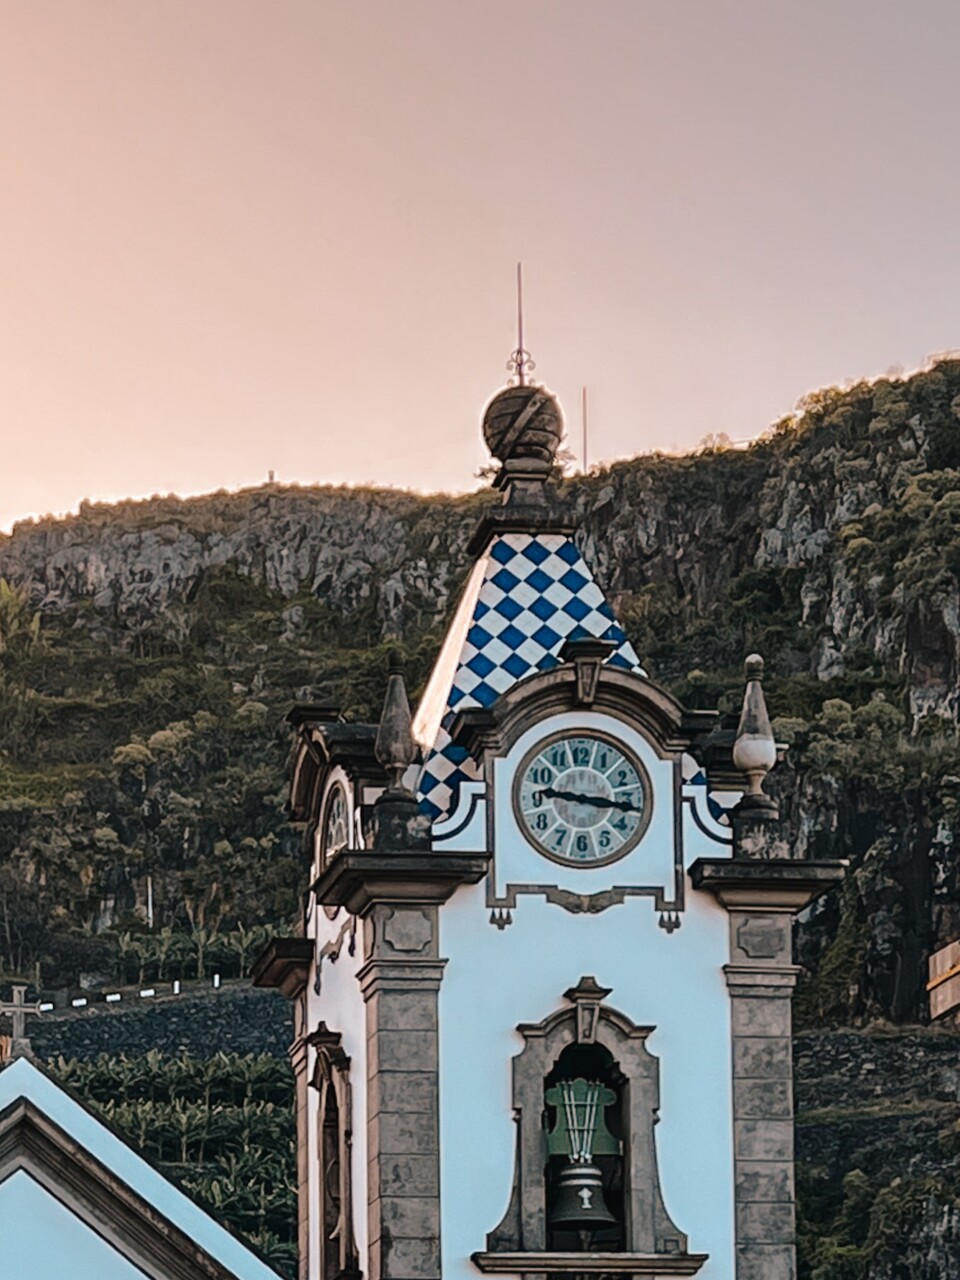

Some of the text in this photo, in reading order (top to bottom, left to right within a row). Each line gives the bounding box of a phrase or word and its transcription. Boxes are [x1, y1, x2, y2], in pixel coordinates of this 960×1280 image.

[551, 750, 566, 766] 11
[572, 747, 589, 765] 12
[600, 752, 608, 768] 1
[533, 767, 552, 784] 10
[618, 770, 628, 786] 2
[532, 791, 542, 808] 9
[536, 813, 548, 830] 8
[612, 816, 628, 831] 4
[554, 828, 567, 846] 7
[576, 834, 588, 852] 6
[599, 830, 611, 847] 5
